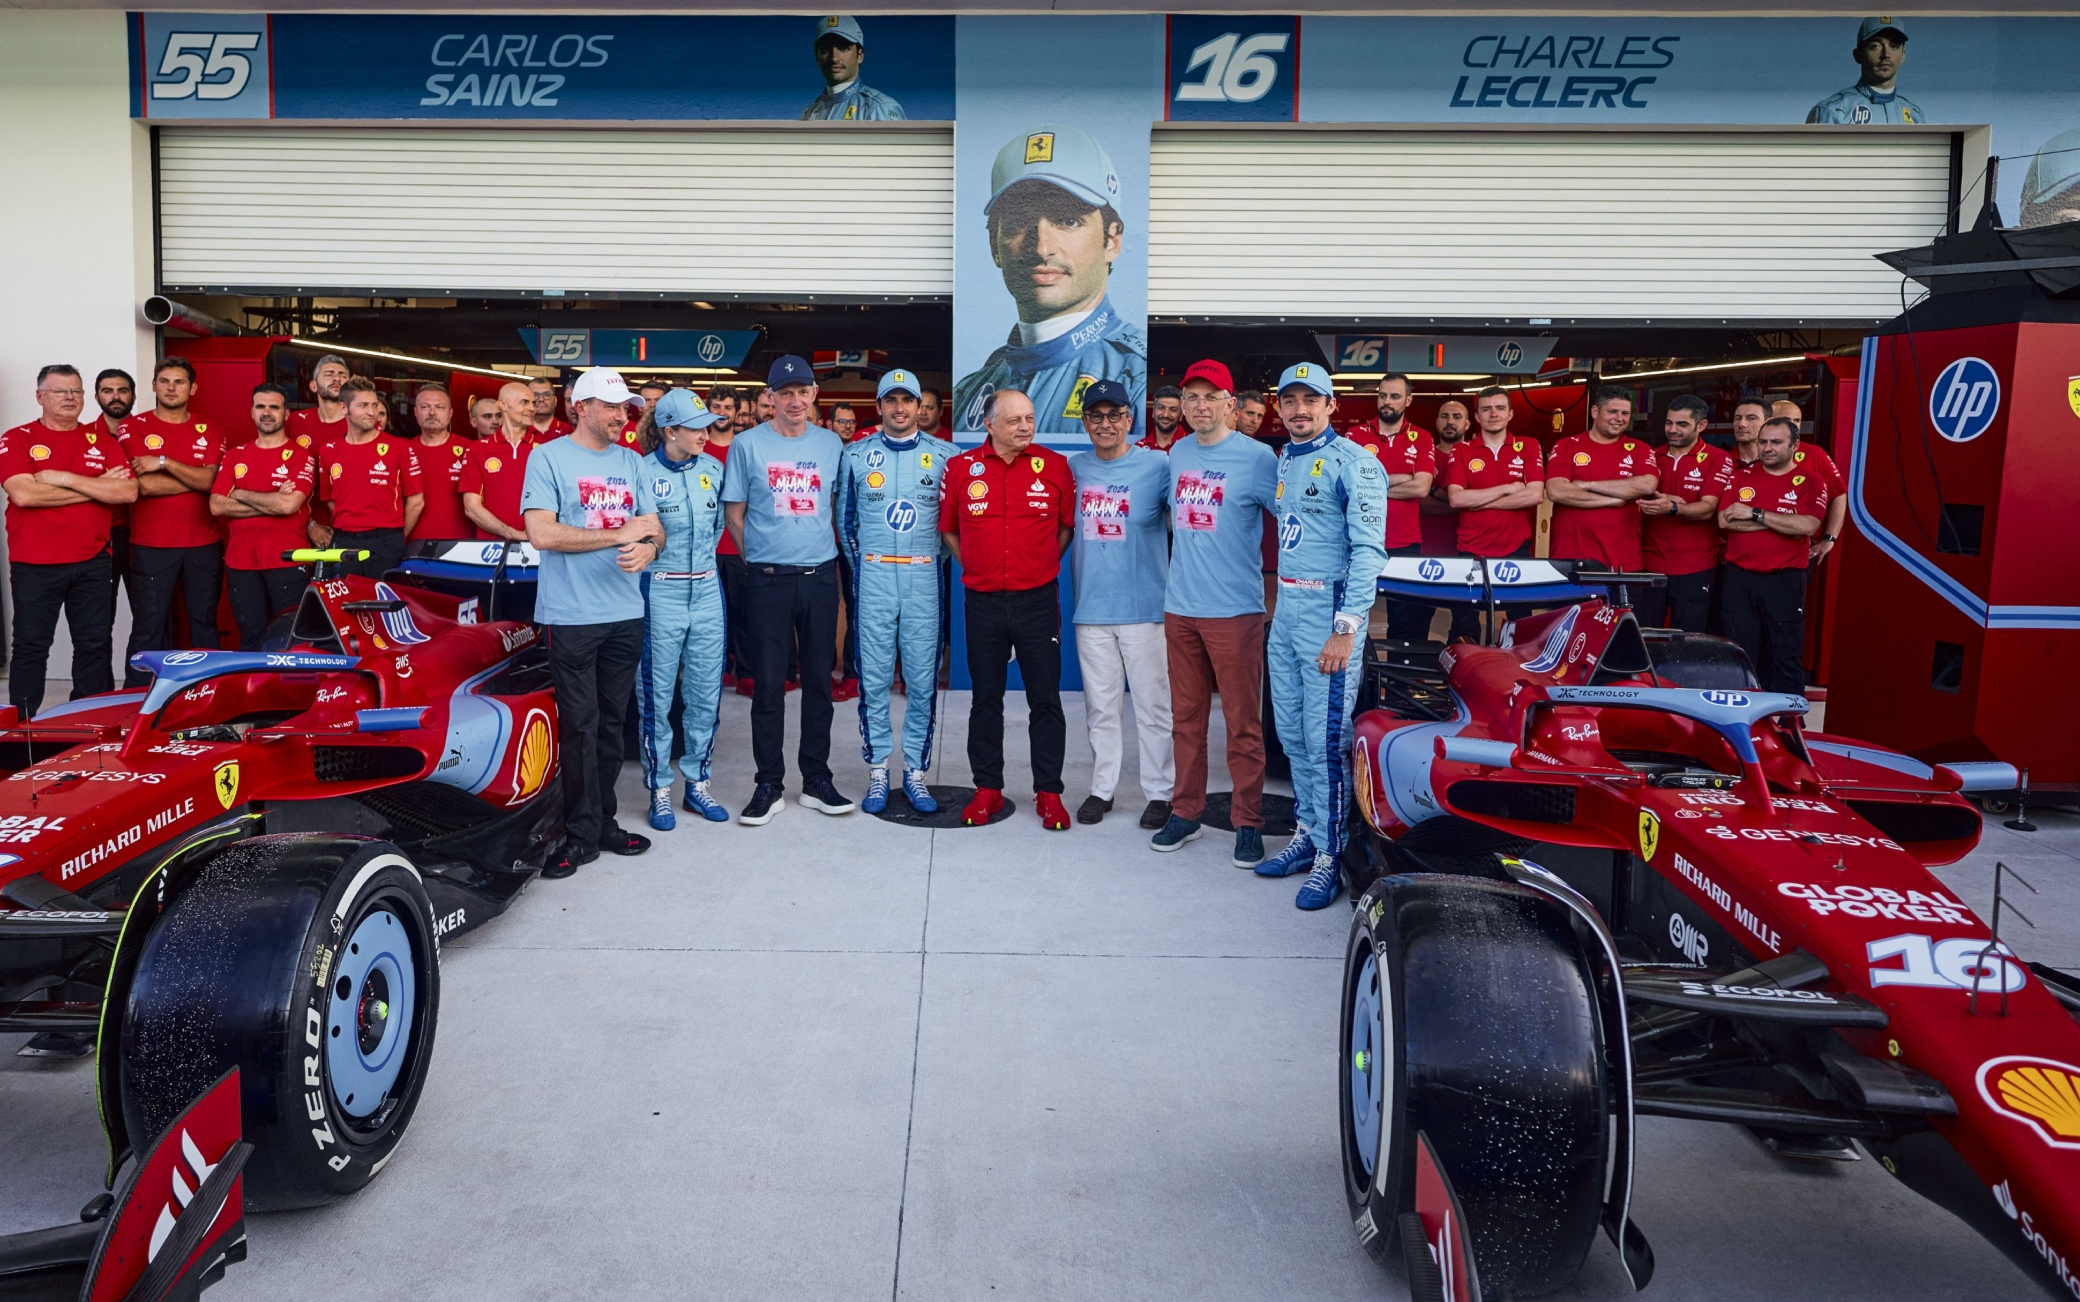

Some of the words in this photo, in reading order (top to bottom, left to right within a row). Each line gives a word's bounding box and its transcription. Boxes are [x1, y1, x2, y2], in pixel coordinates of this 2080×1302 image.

[431, 34, 615, 68] CARLOS
[1463, 35, 1681, 70] CHARLES
[152, 31, 262, 100] 55
[1175, 31, 1291, 102] 16
[420, 74, 566, 107] SAINZ
[1448, 76, 1660, 109] LECLERC
[1107, 174, 1117, 194] hp
[544, 334, 588, 360] 55
[699, 335, 724, 362] hp
[1340, 339, 1385, 367] 16
[1498, 341, 1522, 368] hp
[1936, 358, 1993, 441] hp
[796, 461, 818, 470] 2024
[867, 450, 885, 469] hp
[971, 462, 984, 476] hp
[1360, 466, 1378, 475] aws
[606, 477, 627, 487] 2024
[1202, 470, 1227, 480] 2024
[654, 477, 671, 499] hp
[1107, 485, 1130, 494] 2024
[888, 500, 915, 533] hp
[967, 502, 989, 511] VGW
[482, 543, 503, 564] hp
[1420, 560, 1443, 581] hp
[1496, 561, 1519, 583] hp
[457, 597, 479, 624] 55
[506, 624, 535, 649] Santander
[298, 656, 348, 666] TECHNOLOGY
[395, 654, 409, 670] aws
[316, 686, 347, 703] Ray-Ban
[1578, 690, 1640, 698] TECHNOLOGY
[1562, 723, 1600, 741] Ray-Ban
[438, 756, 459, 772] PUMA
[32, 769, 167, 785] GENESYS
[0, 815, 66, 831] BAL
[61, 825, 141, 881] RICHARD
[147, 797, 195, 835] MILLE
[1740, 828, 1905, 852] GENESYS
[1674, 852, 1731, 912] RICHARD
[1734, 901, 1781, 954] MILLE
[1777, 882, 1969, 911] GLOBAL
[11, 909, 110, 919] ECOPOL
[438, 907, 466, 936] KER
[1808, 899, 1975, 926] POKER
[1865, 933, 2028, 994] 16
[1711, 984, 1835, 1001] ECOPOL
[304, 1006, 336, 1151] ZERO
